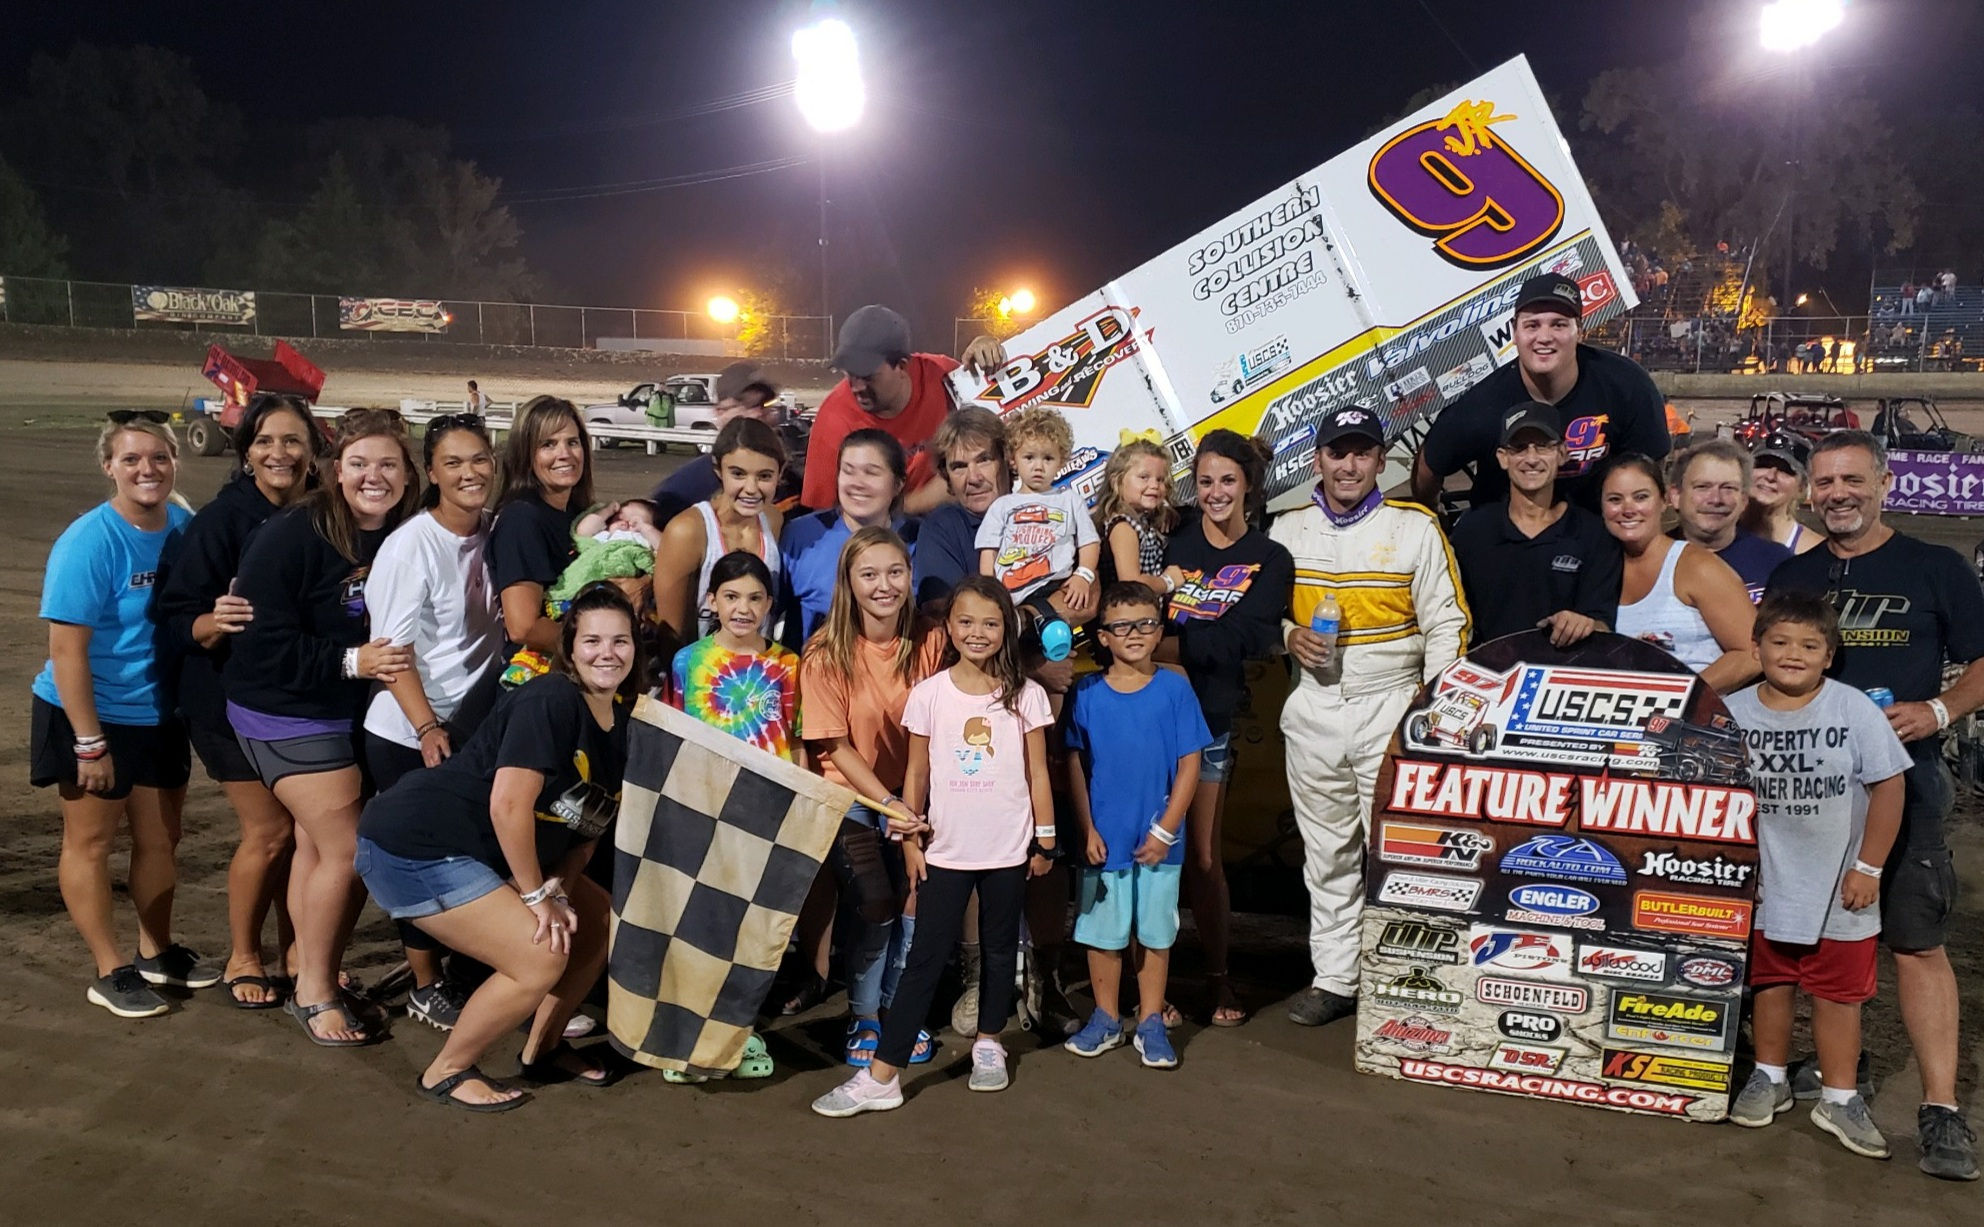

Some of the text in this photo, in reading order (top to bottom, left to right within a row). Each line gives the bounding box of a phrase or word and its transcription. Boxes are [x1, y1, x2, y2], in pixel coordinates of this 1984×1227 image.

[1367, 117, 1566, 272] 9
[1188, 185, 1320, 276] SOUTHERN
[1193, 214, 1324, 300] COLLISION
[1221, 251, 1314, 316] CENTRE
[168, 291, 240, 313] Black Oak
[1224, 270, 1328, 334] 870-735-7444
[1366, 283, 1522, 380] Valvoline
[988, 309, 1131, 405] B & D
[1442, 362, 1490, 393] BULLDOG
[1269, 370, 1358, 432] Hoosier
[1917, 453, 1951, 464] RACE
[1440, 703, 1469, 721] USCS
[1524, 723, 1560, 734] UNITED
[1561, 726, 1597, 737] SPRINT
[1599, 730, 1618, 738] CAR
[1648, 717, 1671, 734] 97
[1519, 738, 1606, 752] PRESENTED BY
[1825, 726, 1850, 749] OF
[1502, 749, 1660, 768] www.uscsracig.com
[1758, 752, 1815, 773] XXL
[1793, 774, 1846, 800] RACING
[1392, 759, 1756, 841] FEATURE WINNER
[1785, 804, 1820, 816] 1991
[1516, 858, 1612, 875] ROCKAUTO.COM
[1637, 851, 1752, 881] Hoosier
[1408, 885, 1451, 898] BMRS
[1670, 874, 1743, 888] RACING TIRE
[1520, 889, 1591, 911] ENGLER
[1640, 900, 1734, 919] BUTLERBUILT
[1505, 909, 1606, 931] MACHINE & TOOL
[1379, 945, 1456, 962] SUSPENSION
[1377, 984, 1460, 1003] HERO
[1485, 983, 1580, 1008] SCHOENFELD
[1618, 995, 1718, 1022] FireAde
[1506, 1013, 1556, 1032] PRO
[1509, 1029, 1549, 1041] SHOCKS
[1403, 1061, 1685, 1112] USCSRACING.COM
